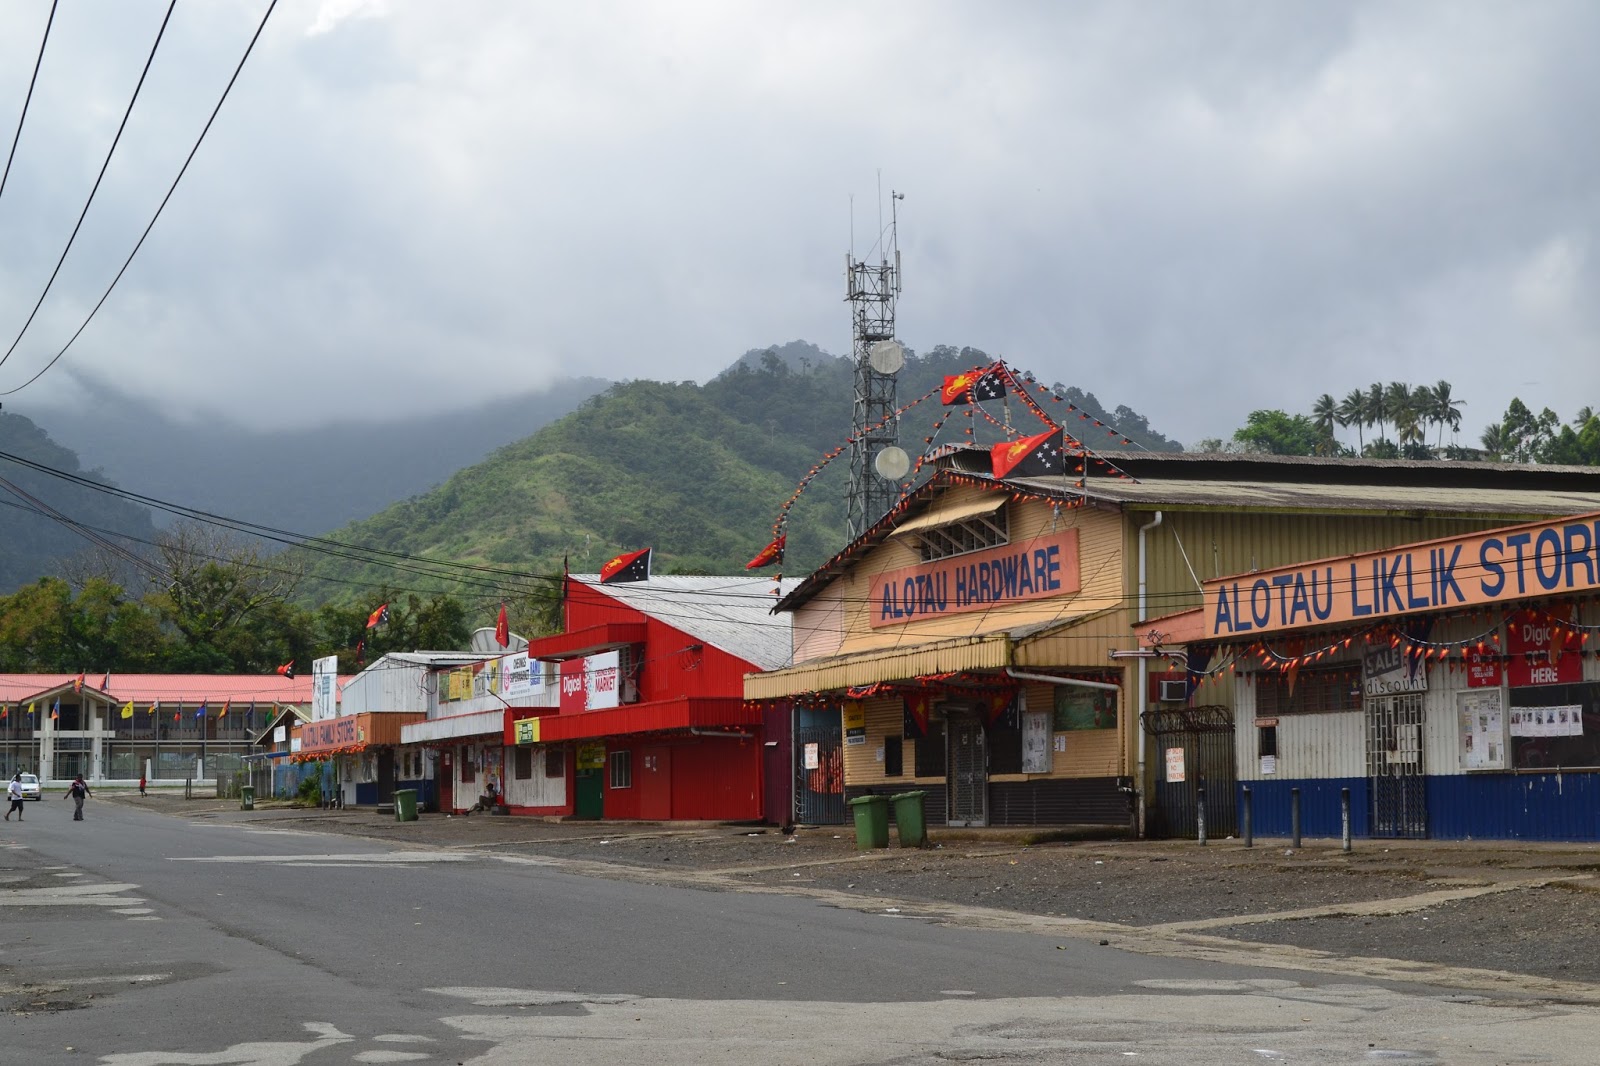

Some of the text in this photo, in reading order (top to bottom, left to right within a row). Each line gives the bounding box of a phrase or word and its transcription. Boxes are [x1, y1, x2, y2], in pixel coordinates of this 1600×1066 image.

[881, 545, 1061, 620] ALOTAU HARDWARE
[1214, 520, 1600, 635] ALOTAU LIKLIK STOR
[1523, 624, 1551, 646] Digic
[1366, 649, 1399, 674] SALE
[563, 674, 582, 697] Digicel
[595, 676, 616, 693] MARKET
[1367, 677, 1426, 694] discount
[1531, 667, 1558, 684] HERE
[337, 720, 354, 743] STORE
